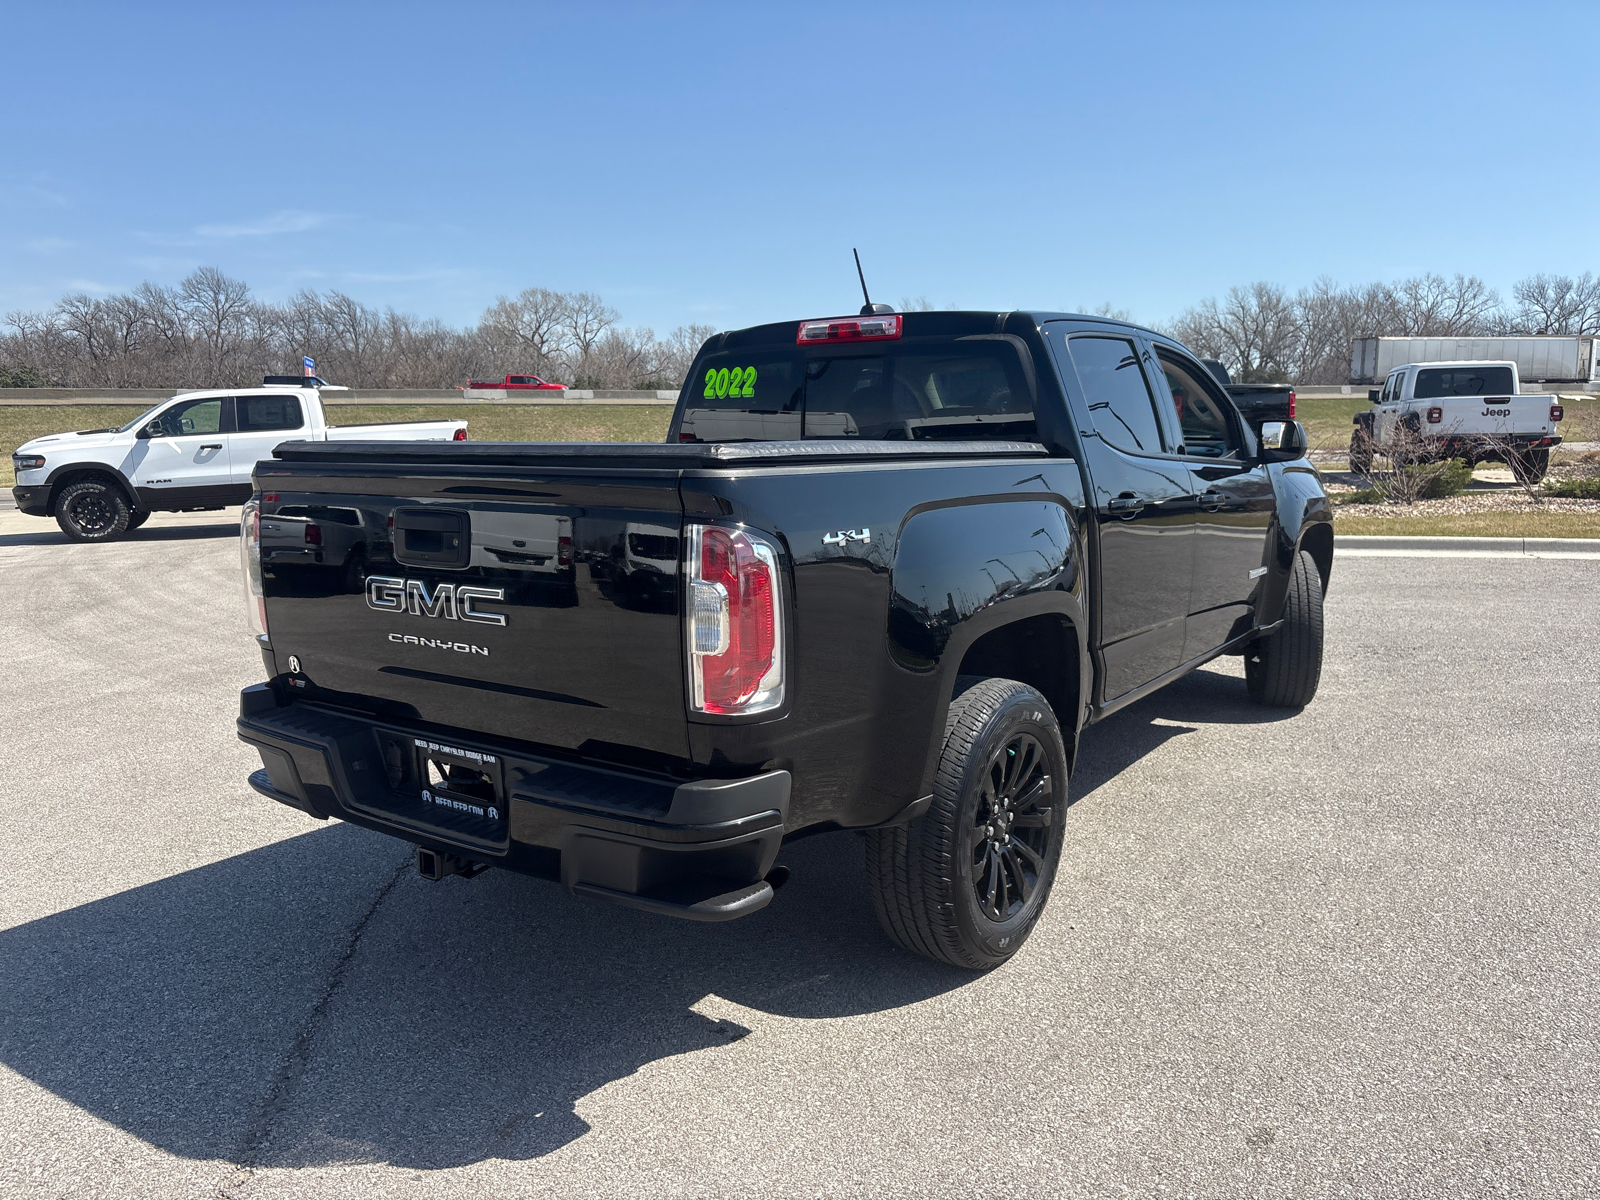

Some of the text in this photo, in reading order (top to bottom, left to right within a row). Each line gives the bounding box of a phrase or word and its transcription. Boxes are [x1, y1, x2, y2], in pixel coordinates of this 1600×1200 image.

[703, 365, 758, 399] 2022
[1481, 407, 1511, 418] Jeep
[365, 575, 507, 626] GMC
[388, 633, 490, 656] CANYON
[415, 739, 495, 763] REED JEEP CHRYSLER DODGE RAM
